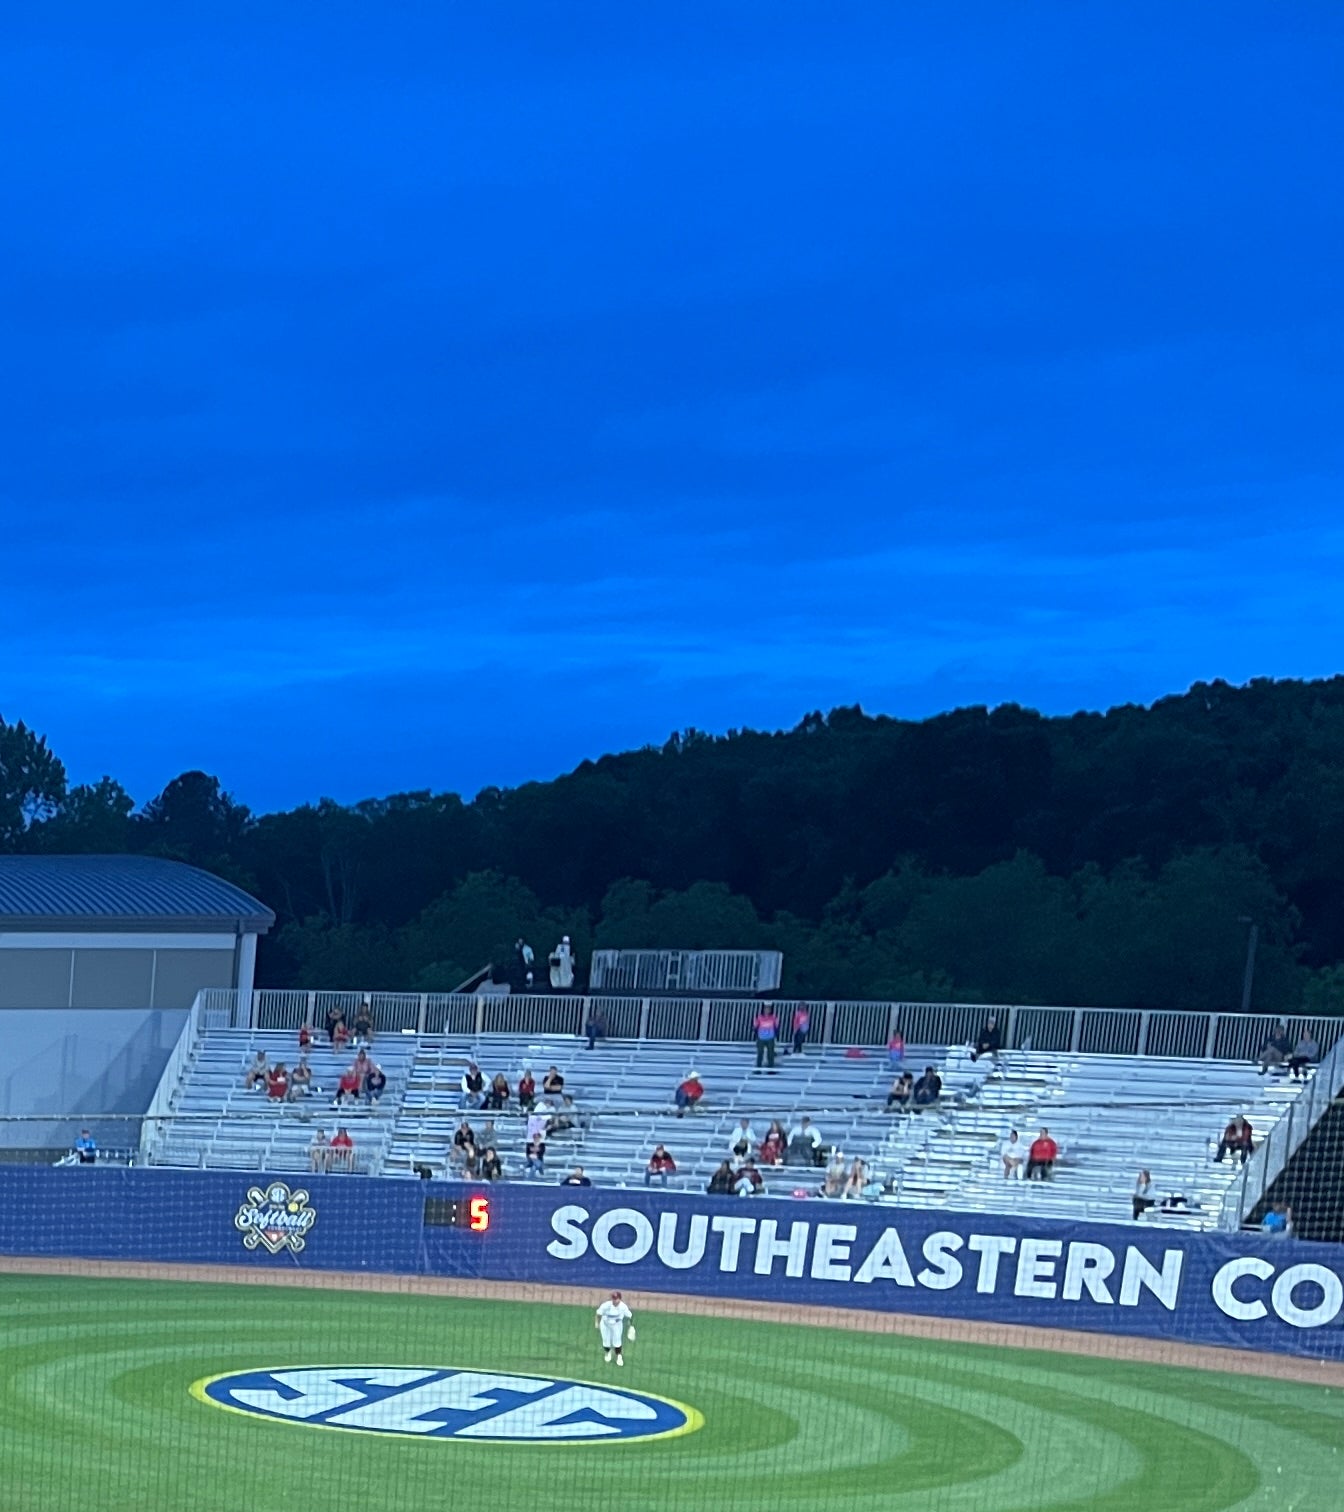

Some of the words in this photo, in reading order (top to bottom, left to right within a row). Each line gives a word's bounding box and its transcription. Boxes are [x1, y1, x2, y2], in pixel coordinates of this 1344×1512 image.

[238, 1207, 312, 1230] Softball
[546, 1204, 1184, 1311] SOUTHEASTERN
[1211, 1256, 1344, 1329] CO
[228, 1367, 658, 1438] SEC
